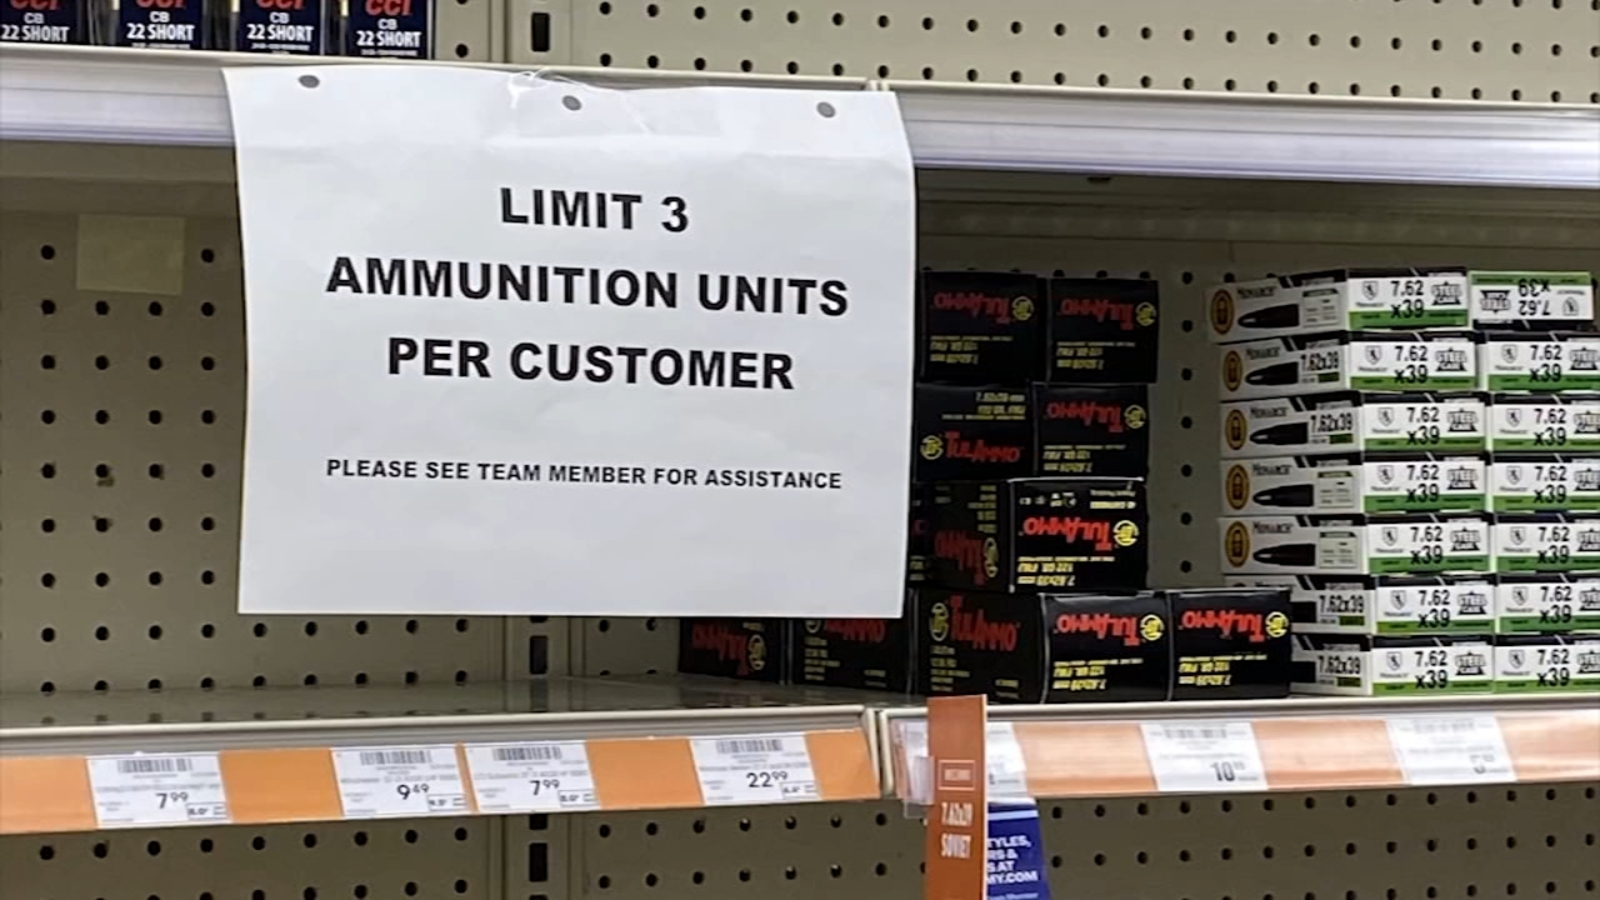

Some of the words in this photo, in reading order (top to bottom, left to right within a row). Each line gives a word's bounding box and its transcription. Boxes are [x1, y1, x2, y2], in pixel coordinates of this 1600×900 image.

[24, 13, 45, 24] CB
[150, 12, 170, 23] CB
[270, 12, 290, 23] CB
[378, 18, 398, 30] CB
[1, 25, 20, 40] 22
[23, 26, 70, 42] SHORT
[126, 23, 146, 39] 22
[148, 24, 196, 41] SHORT
[247, 24, 266, 39] 22
[268, 25, 315, 42] SHORT
[356, 31, 375, 46] 22
[376, 32, 422, 48] SHORT
[502, 188, 641, 229] LIMIT
[662, 197, 687, 232] 3
[327, 257, 676, 308] AMMUNITION
[699, 275, 847, 316] UNITS
[1390, 280, 1424, 296] 7.62
[1518, 278, 1551, 297] x39
[1391, 299, 1425, 319] x39
[1518, 300, 1551, 316] 7.62
[1395, 345, 1428, 361] 7.62
[1530, 344, 1562, 360] 7.62
[390, 338, 490, 377] PER
[511, 343, 793, 389] CUSTOMER
[1529, 362, 1562, 381] x39
[1394, 364, 1428, 383] x39
[1406, 406, 1439, 422] 7.62
[1534, 408, 1566, 424] 7.62
[1406, 425, 1440, 445] x39
[1532, 426, 1566, 446] x39
[328, 460, 416, 477] PLEASE
[426, 462, 469, 479] SEE
[478, 464, 540, 480] TEAM
[550, 466, 645, 483] MEMBER
[655, 469, 696, 485] FOR
[705, 470, 840, 488] ASSISTANCE
[1406, 464, 1439, 480] 7.62
[1534, 465, 1567, 481] 7.62
[1405, 482, 1440, 503] x39
[1532, 483, 1567, 503] x39
[1023, 517, 1113, 551] TULAMMO
[1410, 526, 1442, 542] 7.62
[1538, 526, 1570, 542] 7.62
[1410, 544, 1443, 564] x39
[1537, 544, 1571, 564] x39
[1418, 589, 1450, 606] 7.62
[1539, 586, 1572, 602] 7.62
[1418, 608, 1450, 628] x39
[1539, 604, 1572, 624] x39
[1057, 613, 1137, 646] TULAMMO
[1183, 610, 1264, 643] TULAMMO
[1414, 650, 1448, 667] 7.62
[1537, 648, 1569, 665] 7.62
[1414, 669, 1448, 689] x39
[1536, 667, 1569, 688] x39
